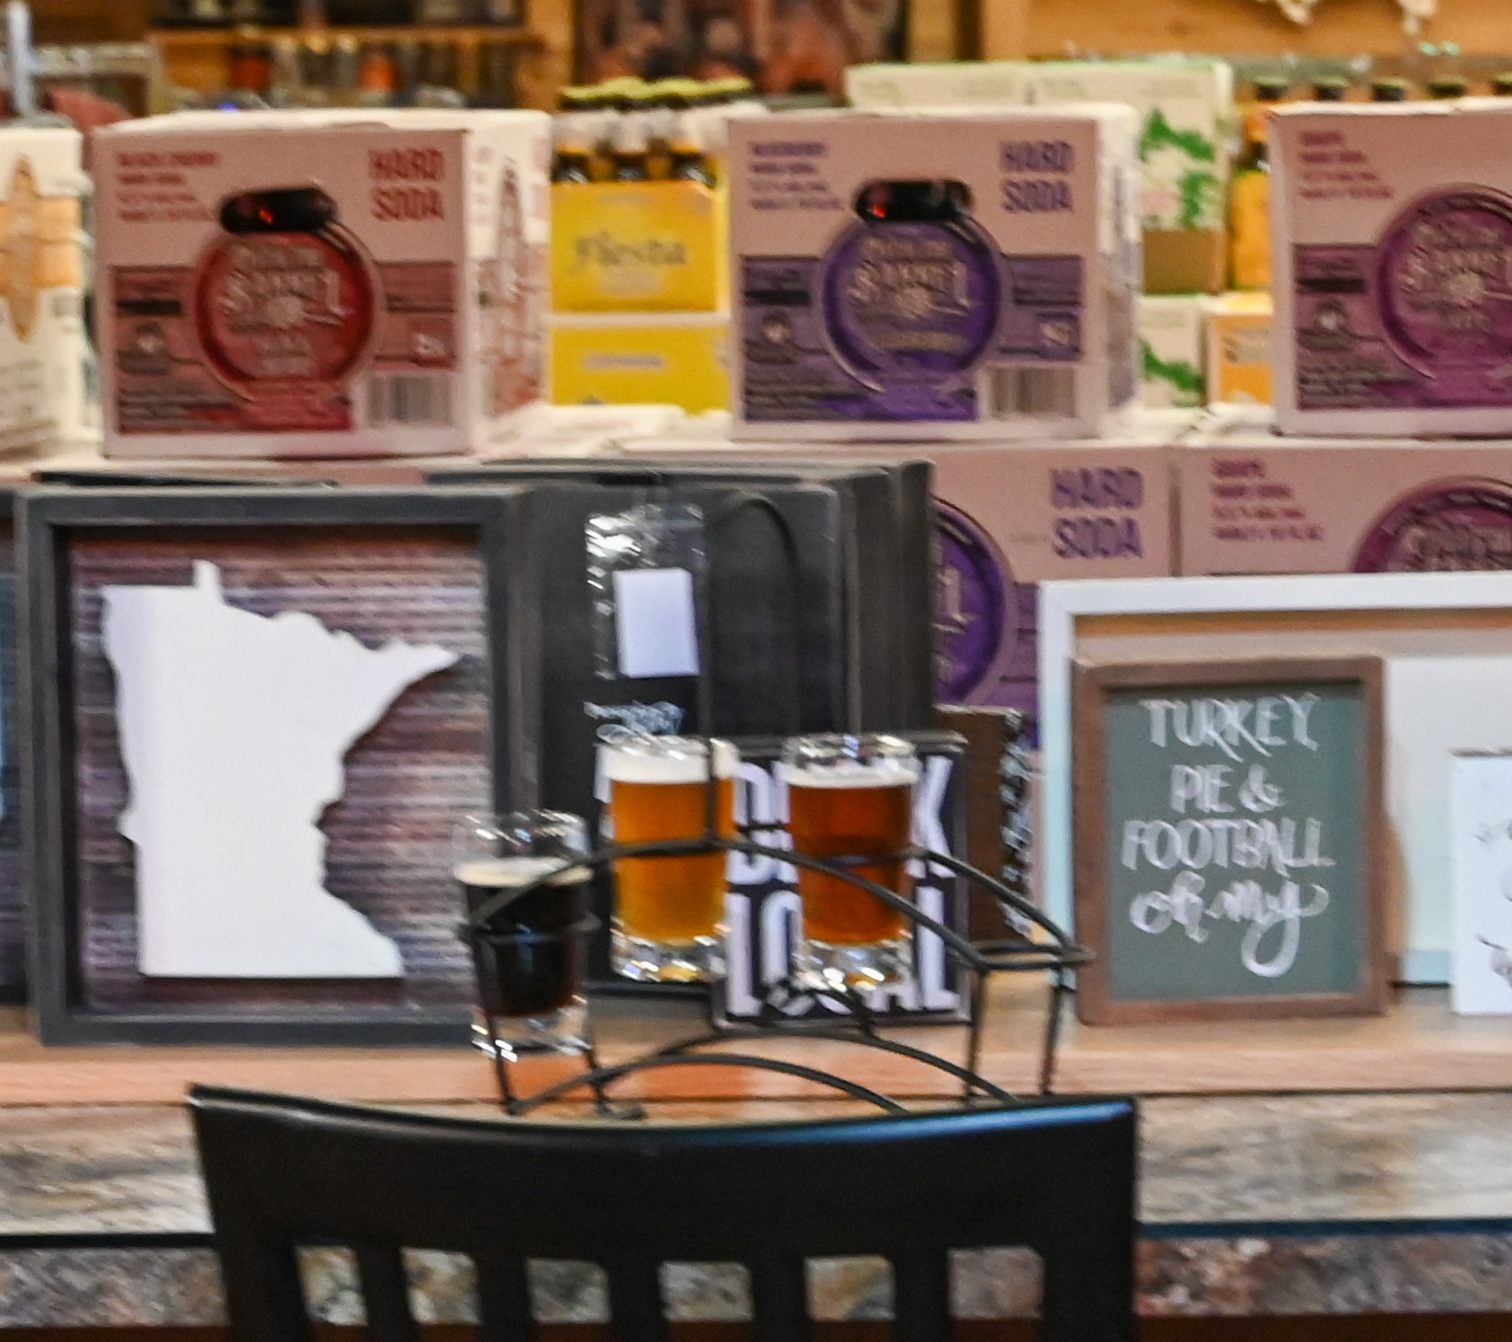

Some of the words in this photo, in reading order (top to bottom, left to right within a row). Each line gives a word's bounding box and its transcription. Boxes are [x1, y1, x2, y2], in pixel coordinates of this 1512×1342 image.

[1139, 692, 1320, 762] TURKEY
[1170, 764, 1236, 814] PIE
[1238, 764, 1285, 813] &
[1121, 817, 1336, 878] FOOTBALL
[725, 889, 962, 1019] LOL
[1129, 870, 1210, 943] oh
[1204, 879, 1330, 978] my
